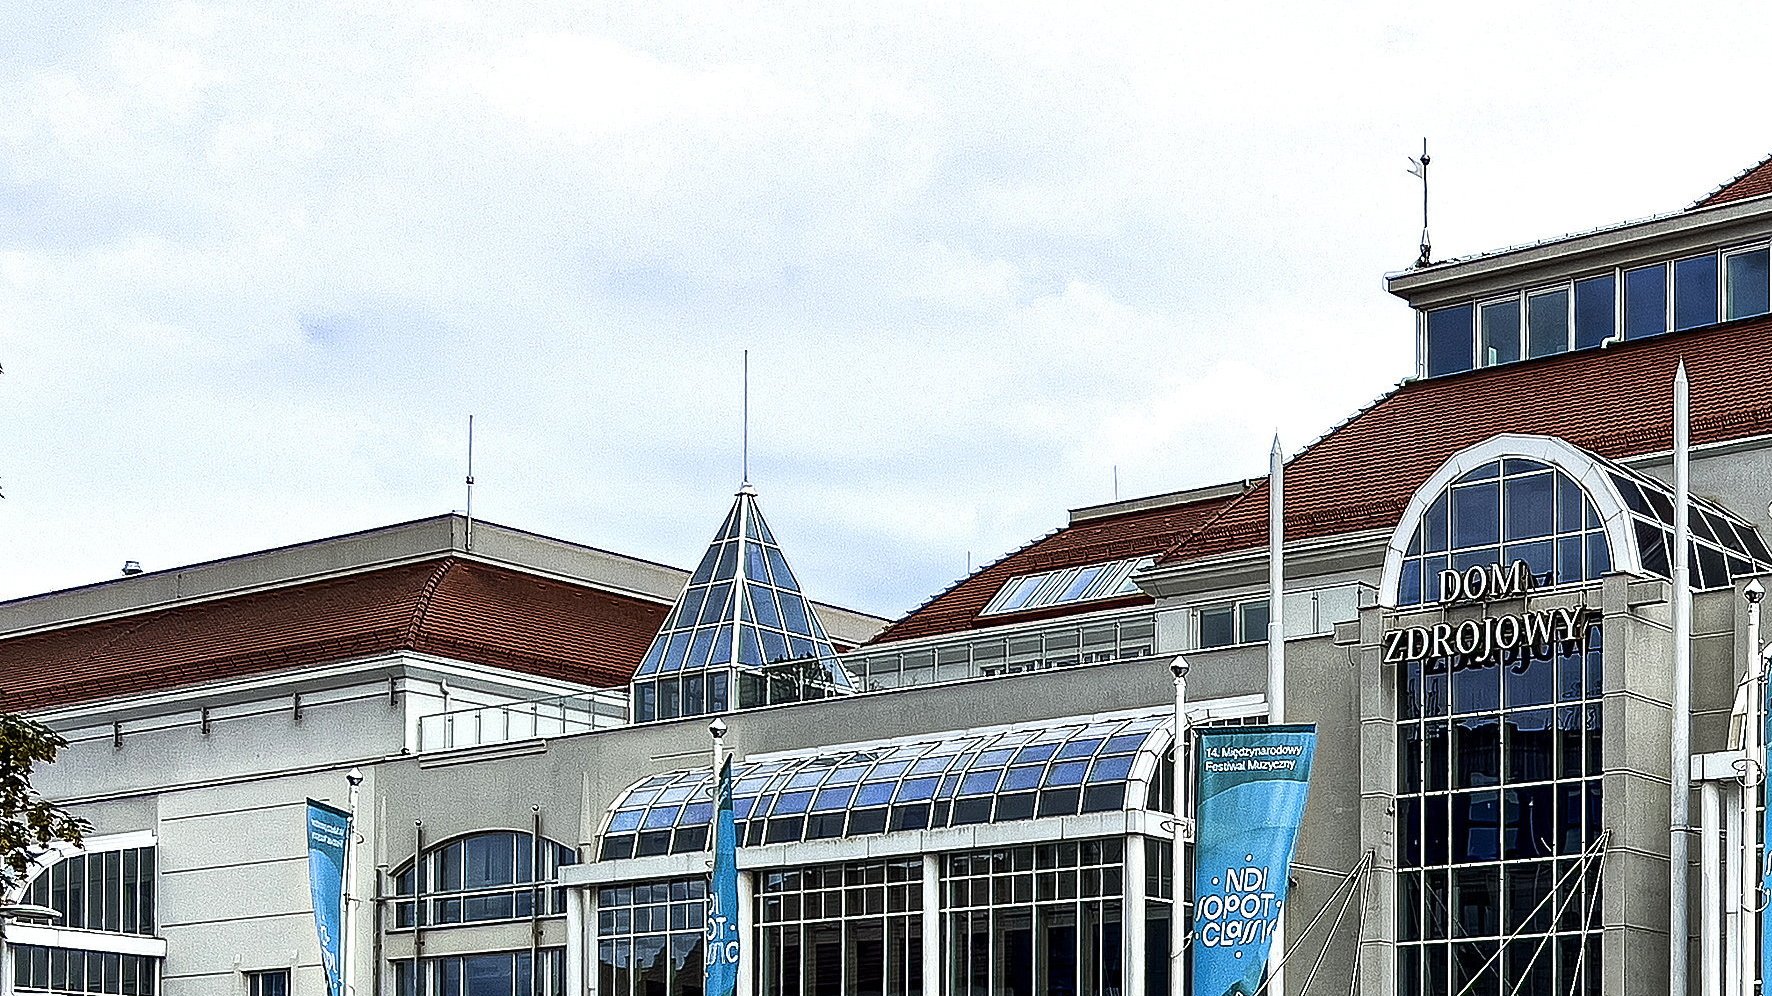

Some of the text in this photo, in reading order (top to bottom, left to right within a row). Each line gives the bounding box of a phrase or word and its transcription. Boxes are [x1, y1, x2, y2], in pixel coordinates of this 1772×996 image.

[1438, 559, 1523, 603] DOM
[1383, 604, 1584, 664] ZDROJOWY
[1221, 745, 1303, 759] Międzynarodowy
[1205, 759, 1296, 772] Festiwal Muzyczny
[1225, 866, 1269, 892] NDI
